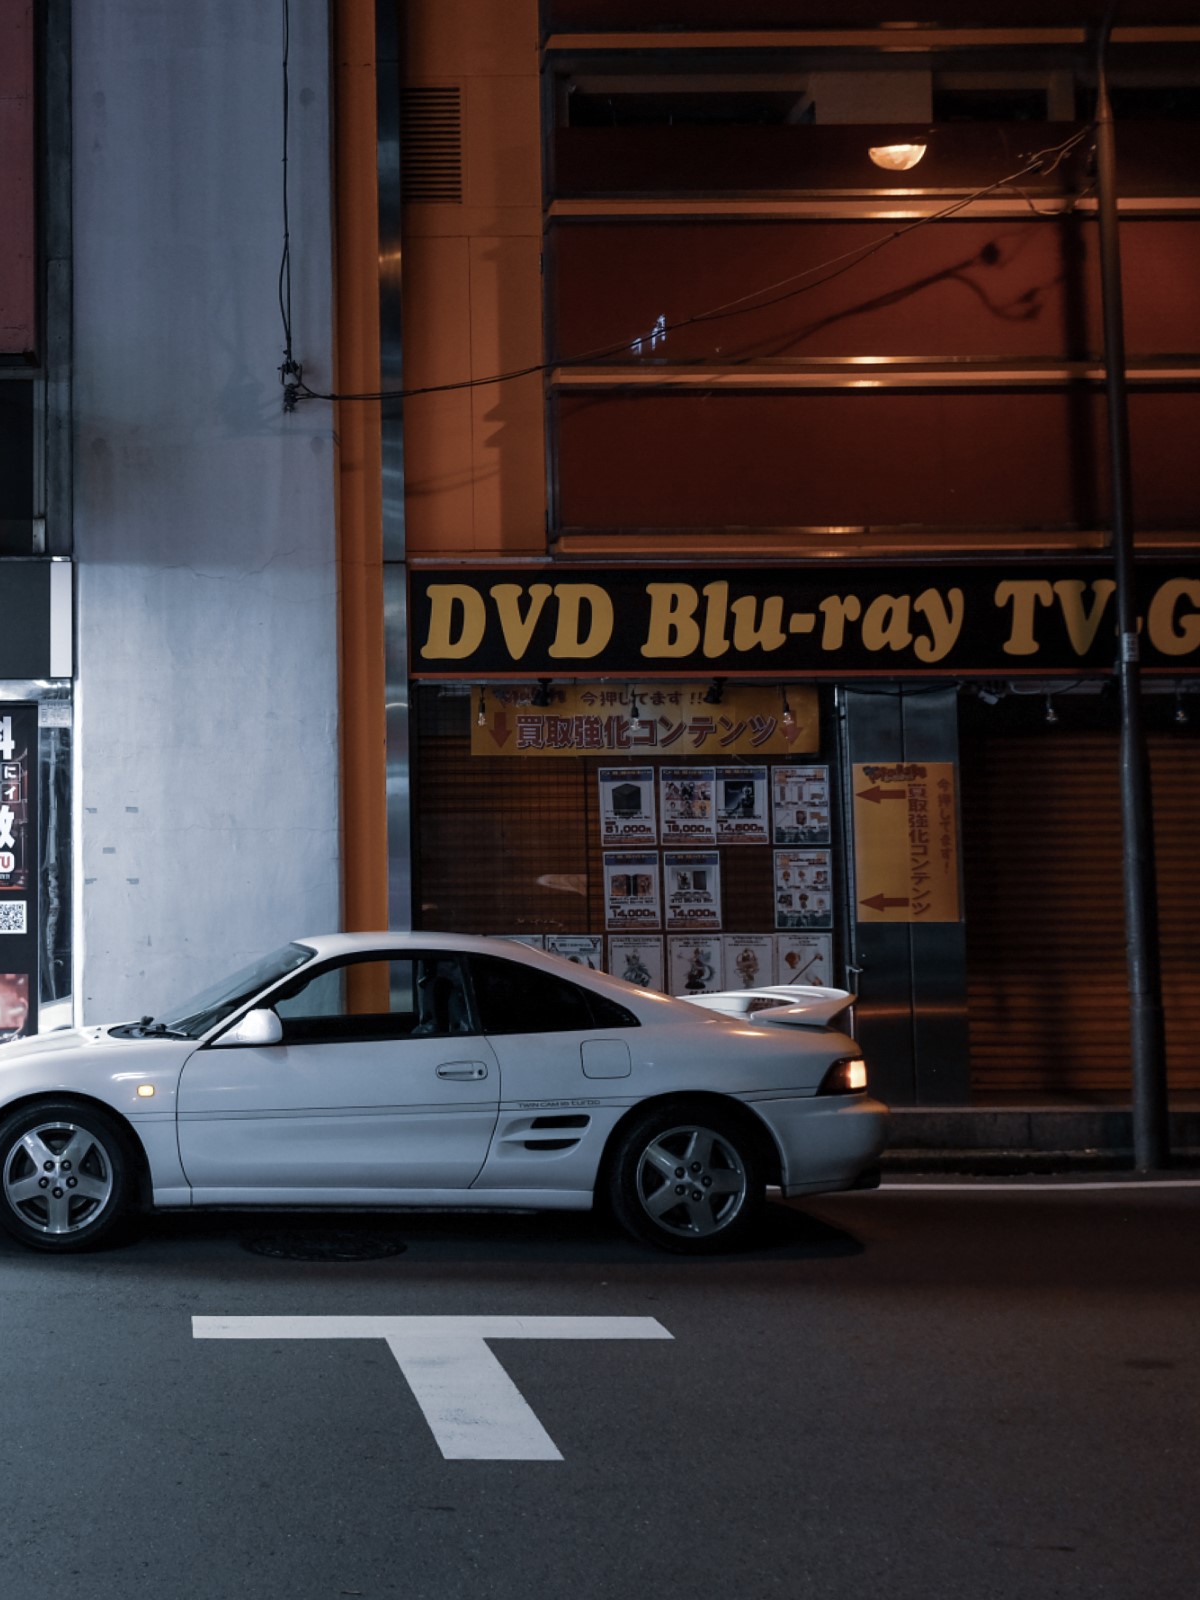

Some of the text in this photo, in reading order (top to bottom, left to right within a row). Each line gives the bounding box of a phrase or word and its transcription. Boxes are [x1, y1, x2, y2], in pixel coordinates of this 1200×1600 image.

[420, 582, 615, 660] DVD
[640, 580, 966, 664] Blu-ray
[516, 714, 779, 749] 買取強化コンテンツ
[908, 783, 932, 916] 買取強化コンテンツ
